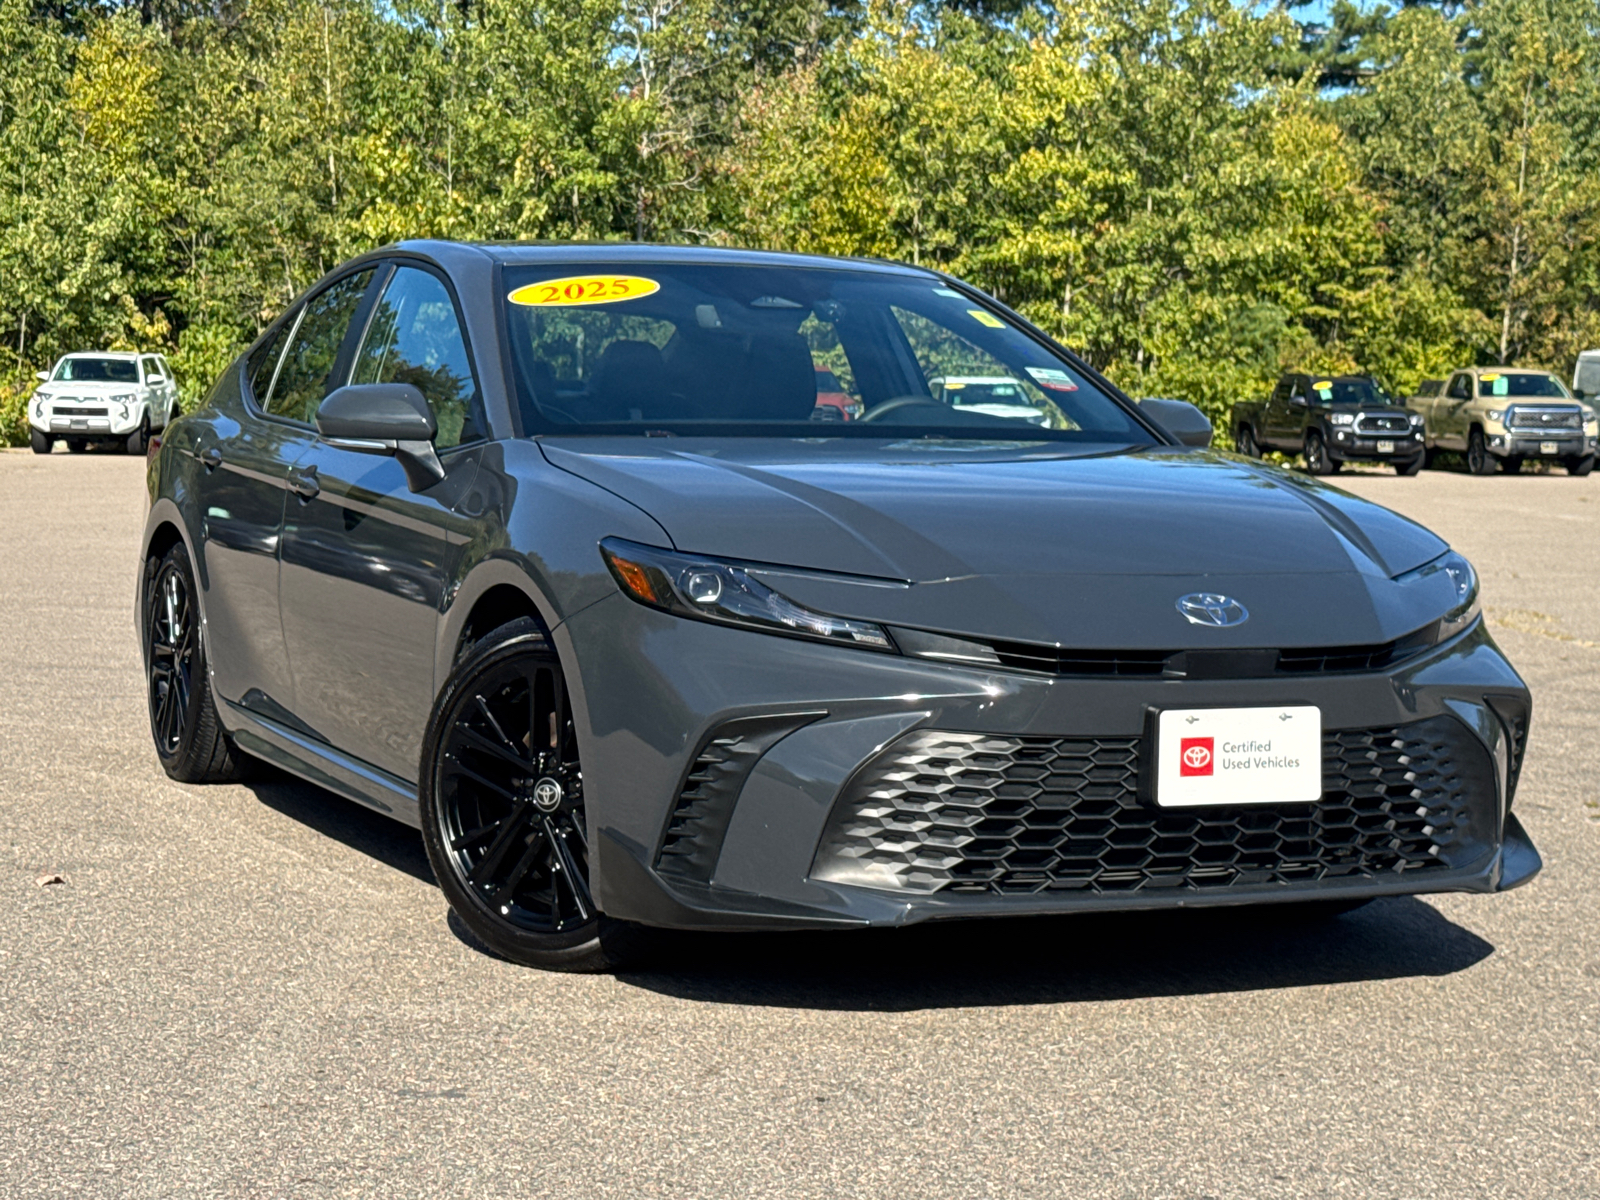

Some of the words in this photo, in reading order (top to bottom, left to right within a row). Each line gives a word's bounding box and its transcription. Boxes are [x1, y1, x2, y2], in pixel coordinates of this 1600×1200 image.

[540, 279, 630, 303] 2025
[1222, 740, 1271, 753] Certified
[1222, 757, 1251, 769] Used
[1253, 756, 1300, 769] Vehicles
